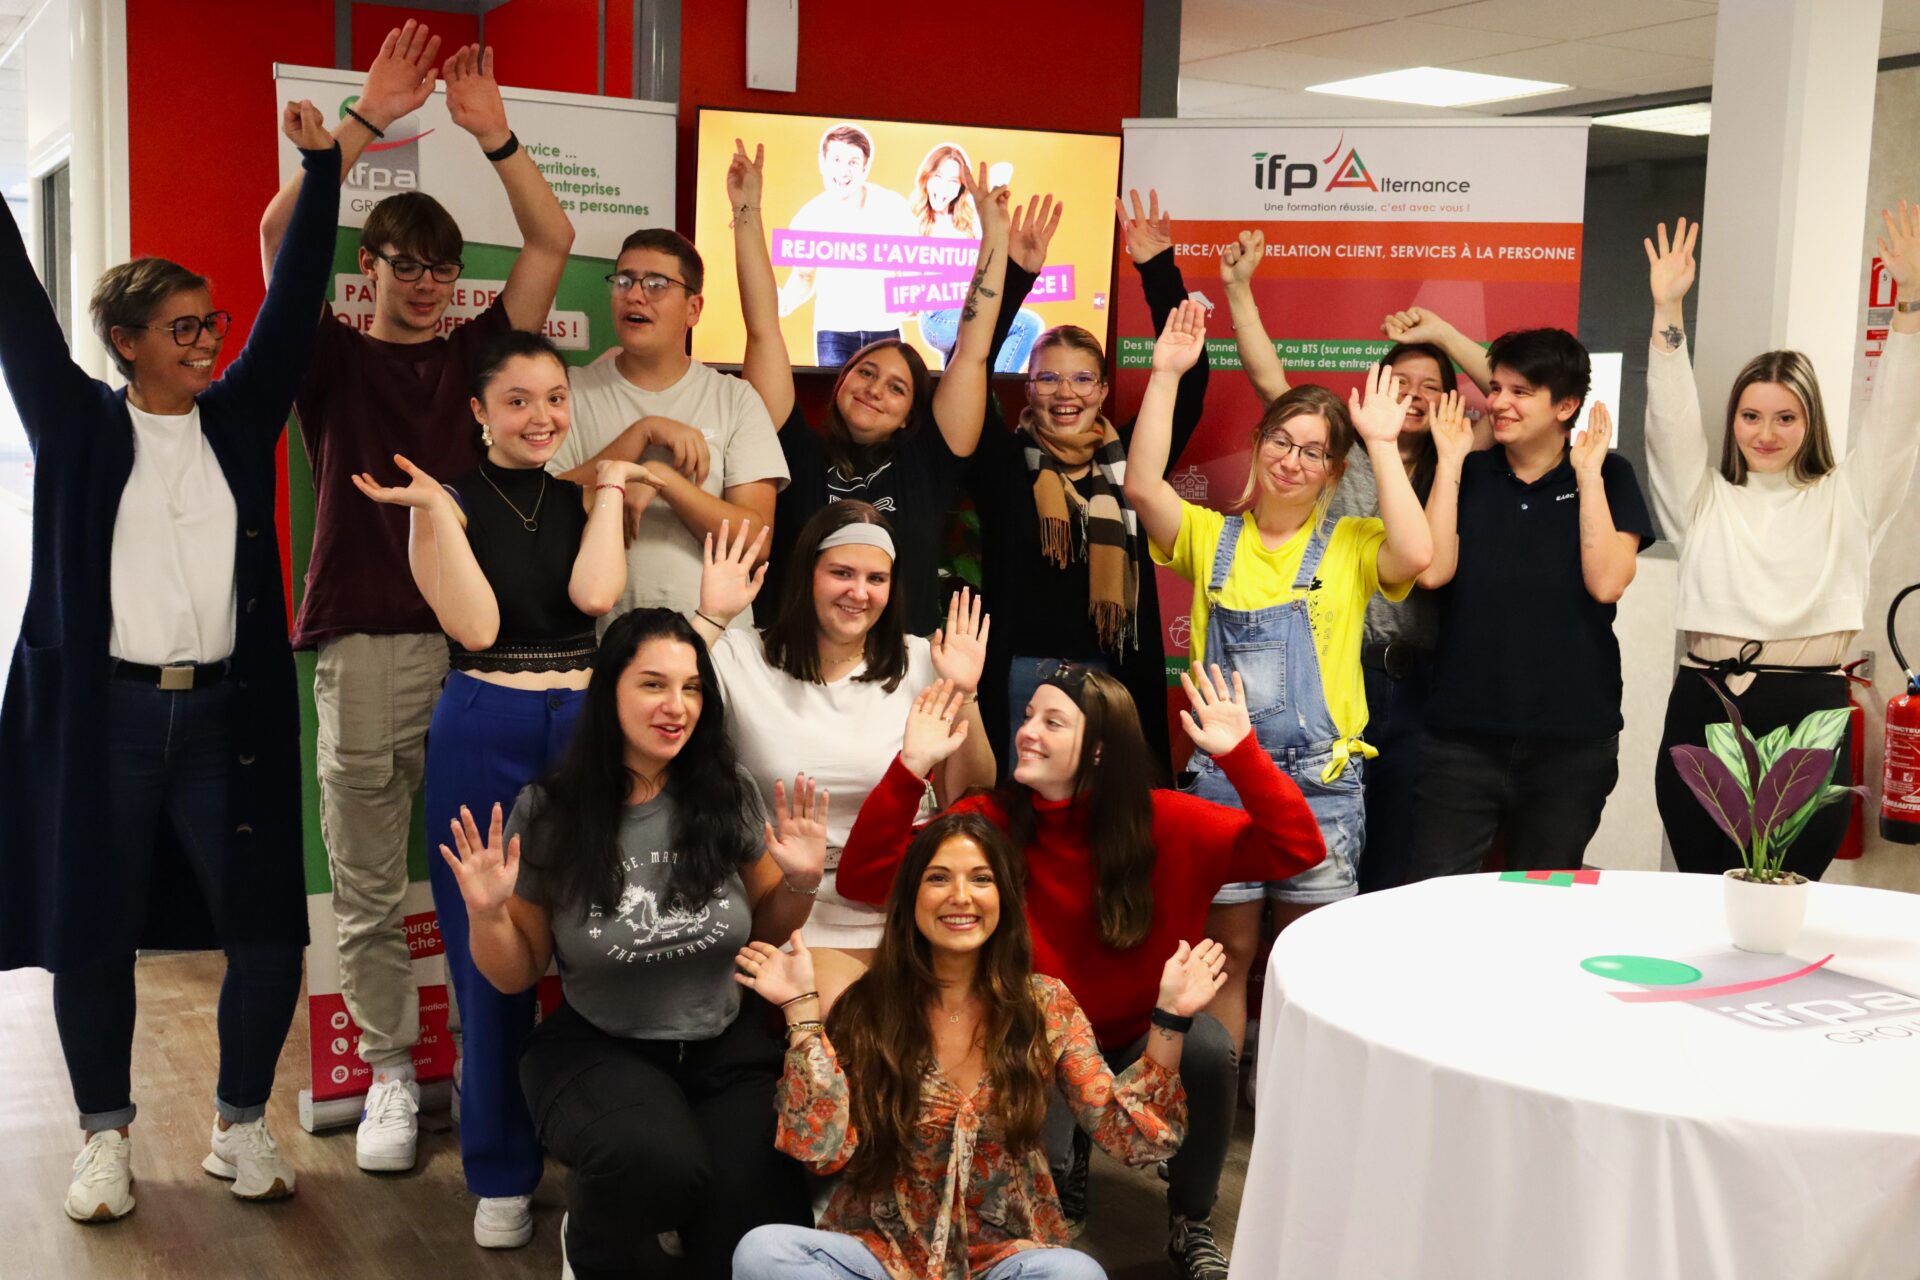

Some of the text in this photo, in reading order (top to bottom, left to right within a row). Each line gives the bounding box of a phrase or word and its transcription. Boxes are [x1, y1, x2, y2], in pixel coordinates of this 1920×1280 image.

[524, 143, 560, 157] rvice
[535, 162, 600, 179] erritoires,
[558, 199, 649, 216] es personnes
[1264, 202, 1284, 212] Une
[1287, 202, 1337, 212] formation
[1380, 203, 1406, 212] c'est
[1410, 204, 1436, 212] avec
[1440, 204, 1463, 212] vous
[781, 239, 979, 267] REJOINS L'AVENTUR
[1266, 245, 1330, 257] RELATION
[1335, 244, 1386, 259] CLIENT,
[1390, 245, 1456, 258] SERVICES
[1460, 243, 1472, 258] À
[1476, 247, 1494, 259] LA
[1498, 247, 1575, 260] PERSONNE
[1123, 340, 1142, 350] Des
[1286, 345, 1299, 353] au
[1302, 344, 1318, 354] BTS
[1320, 344, 1339, 356] (sur
[1342, 347, 1362, 355] une
[1365, 345, 1390, 355] duré
[1123, 356, 1146, 365] pour
[1281, 359, 1315, 367] ttentes
[1318, 358, 1336, 368] des
[409, 937, 442, 951] che-
[607, 944, 637, 963] THE
[413, 1057, 432, 1066] com
